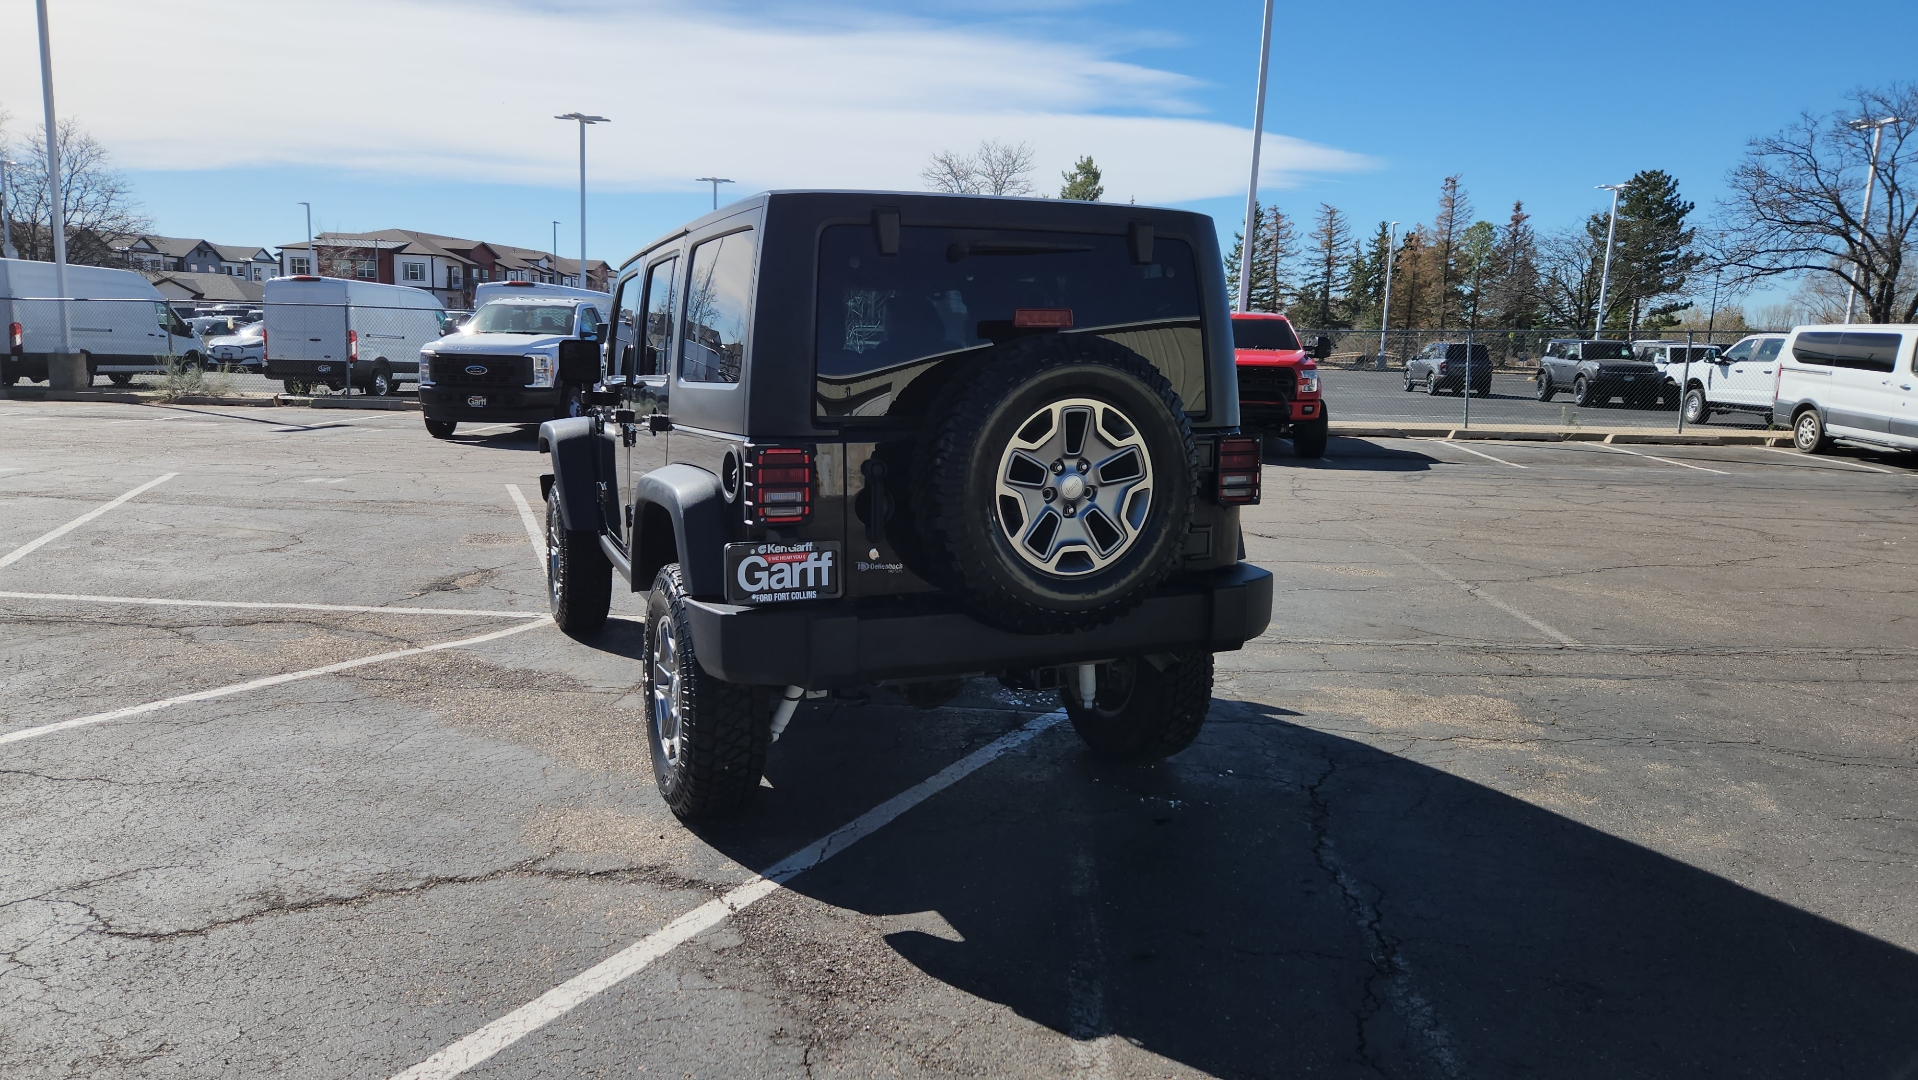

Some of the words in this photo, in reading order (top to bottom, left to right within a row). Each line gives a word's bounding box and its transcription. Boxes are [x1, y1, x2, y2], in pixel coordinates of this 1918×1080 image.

[767, 544, 787, 553] Ken
[788, 542, 813, 552] Garff
[738, 551, 833, 592] Garff
[756, 594, 772, 602] FORD
[774, 593, 790, 601] FORT
[791, 591, 816, 600] COLLINS
